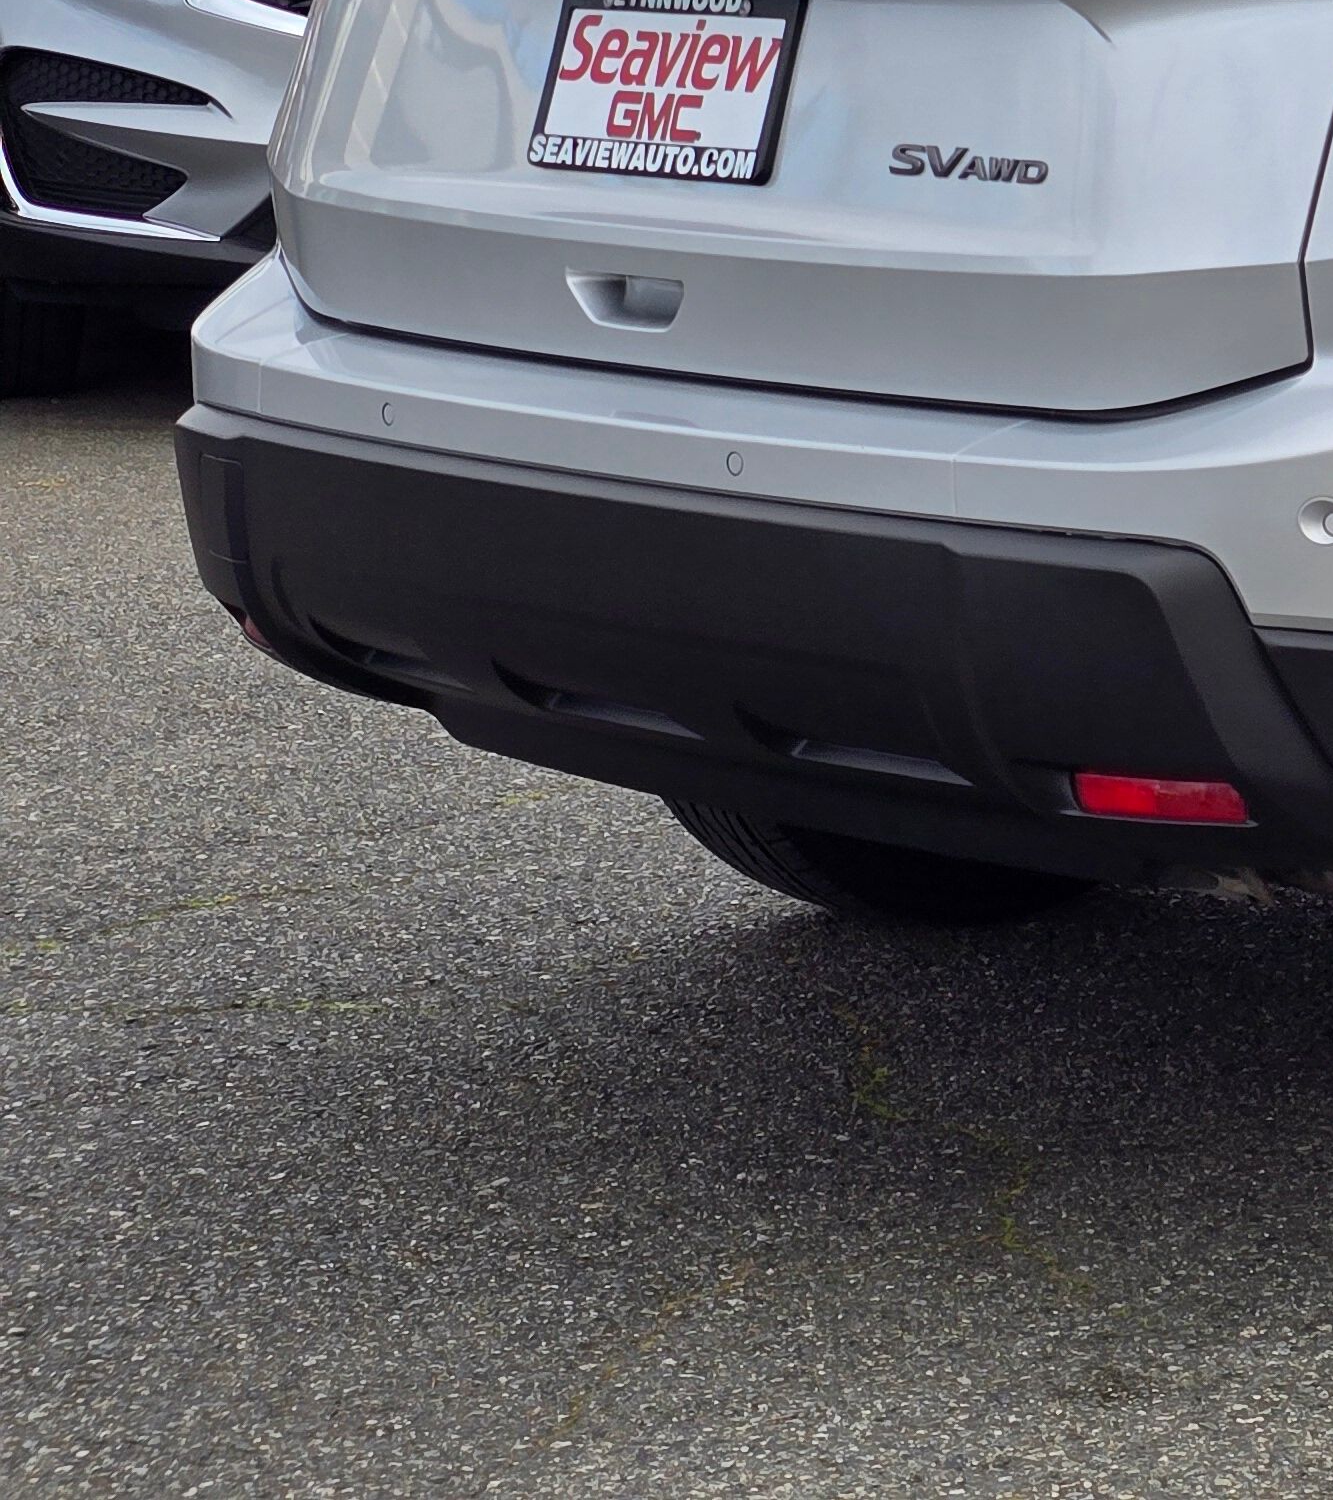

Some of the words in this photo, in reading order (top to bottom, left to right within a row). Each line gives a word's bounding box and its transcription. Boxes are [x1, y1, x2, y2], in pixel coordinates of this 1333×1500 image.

[558, 14, 783, 93] Seaview
[606, 90, 704, 143] GMC
[529, 133, 757, 180] SEAVIEWAUTO.COM
